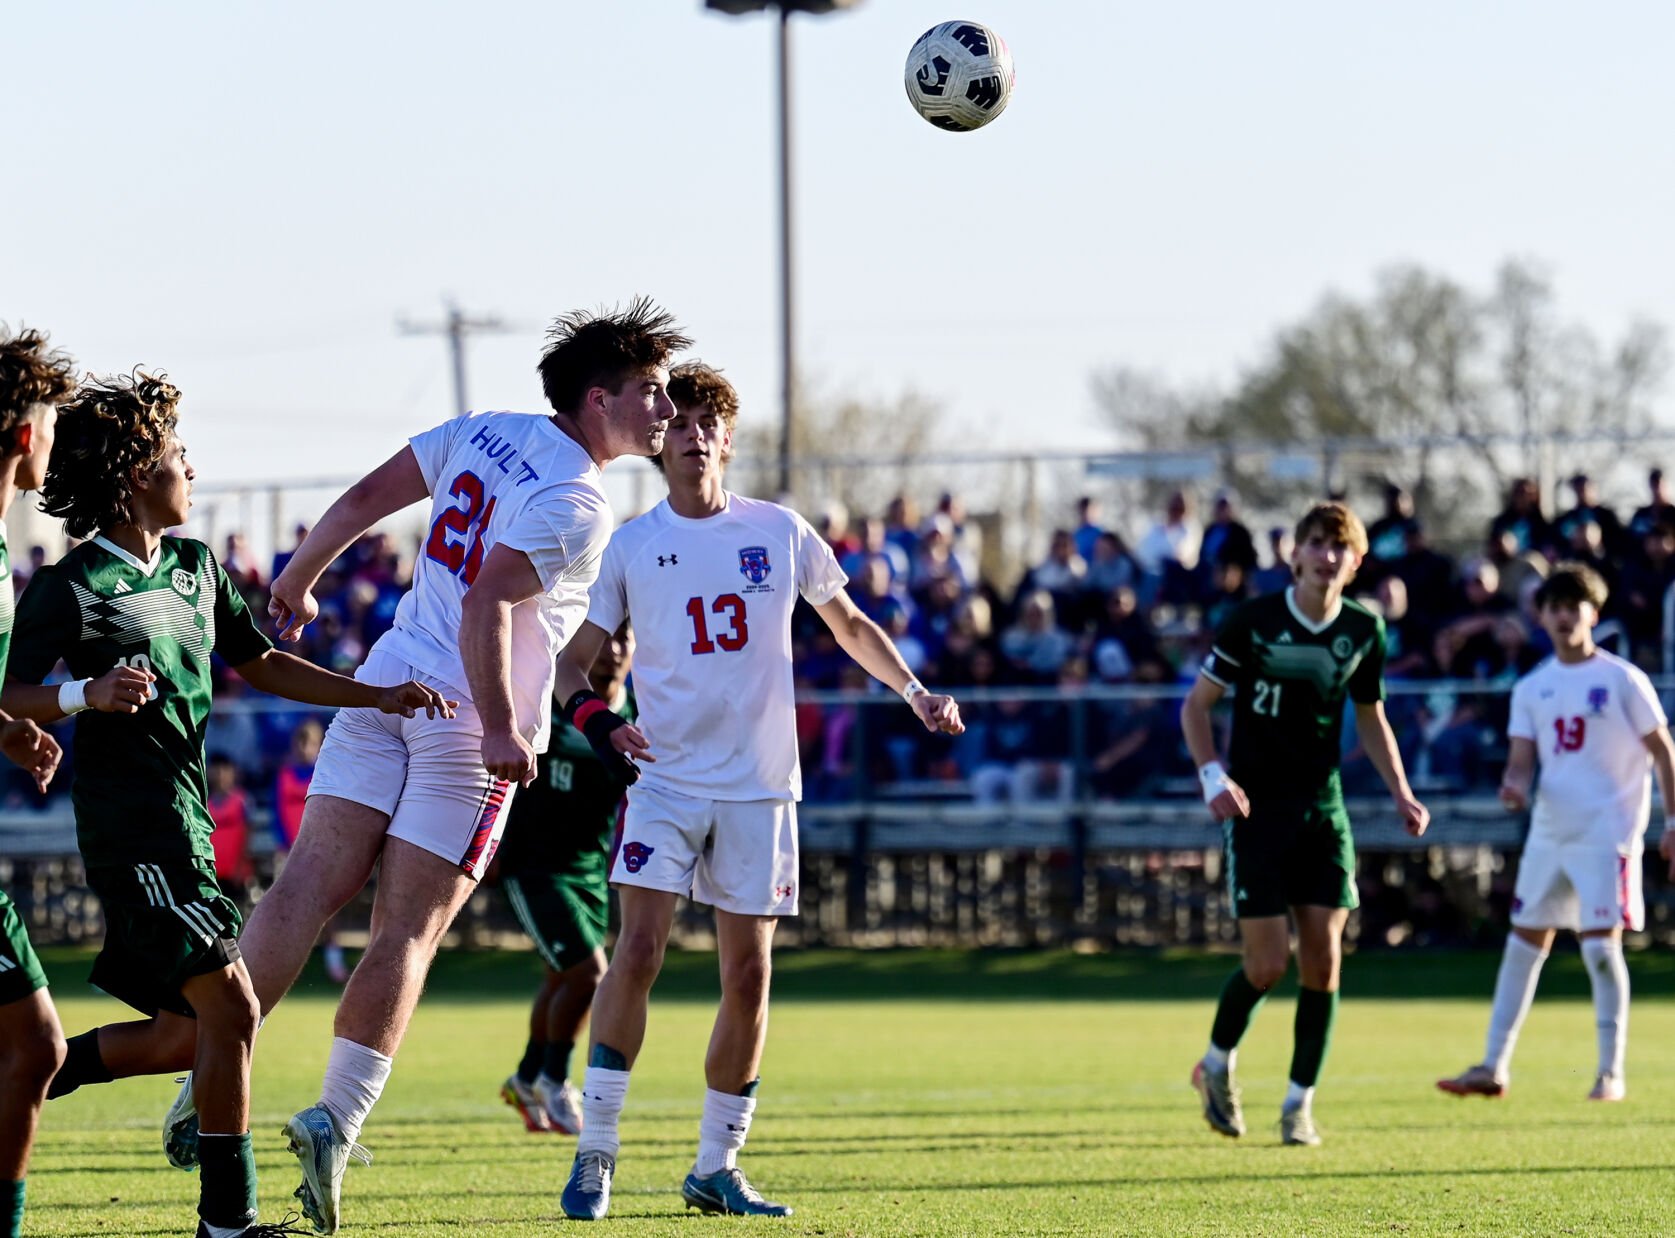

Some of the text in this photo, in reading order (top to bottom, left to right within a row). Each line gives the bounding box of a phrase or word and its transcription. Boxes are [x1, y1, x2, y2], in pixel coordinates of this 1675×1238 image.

[470, 425, 540, 487] HULT
[686, 592, 749, 656] 13
[1253, 680, 1281, 717] 21
[550, 758, 574, 792] 19
